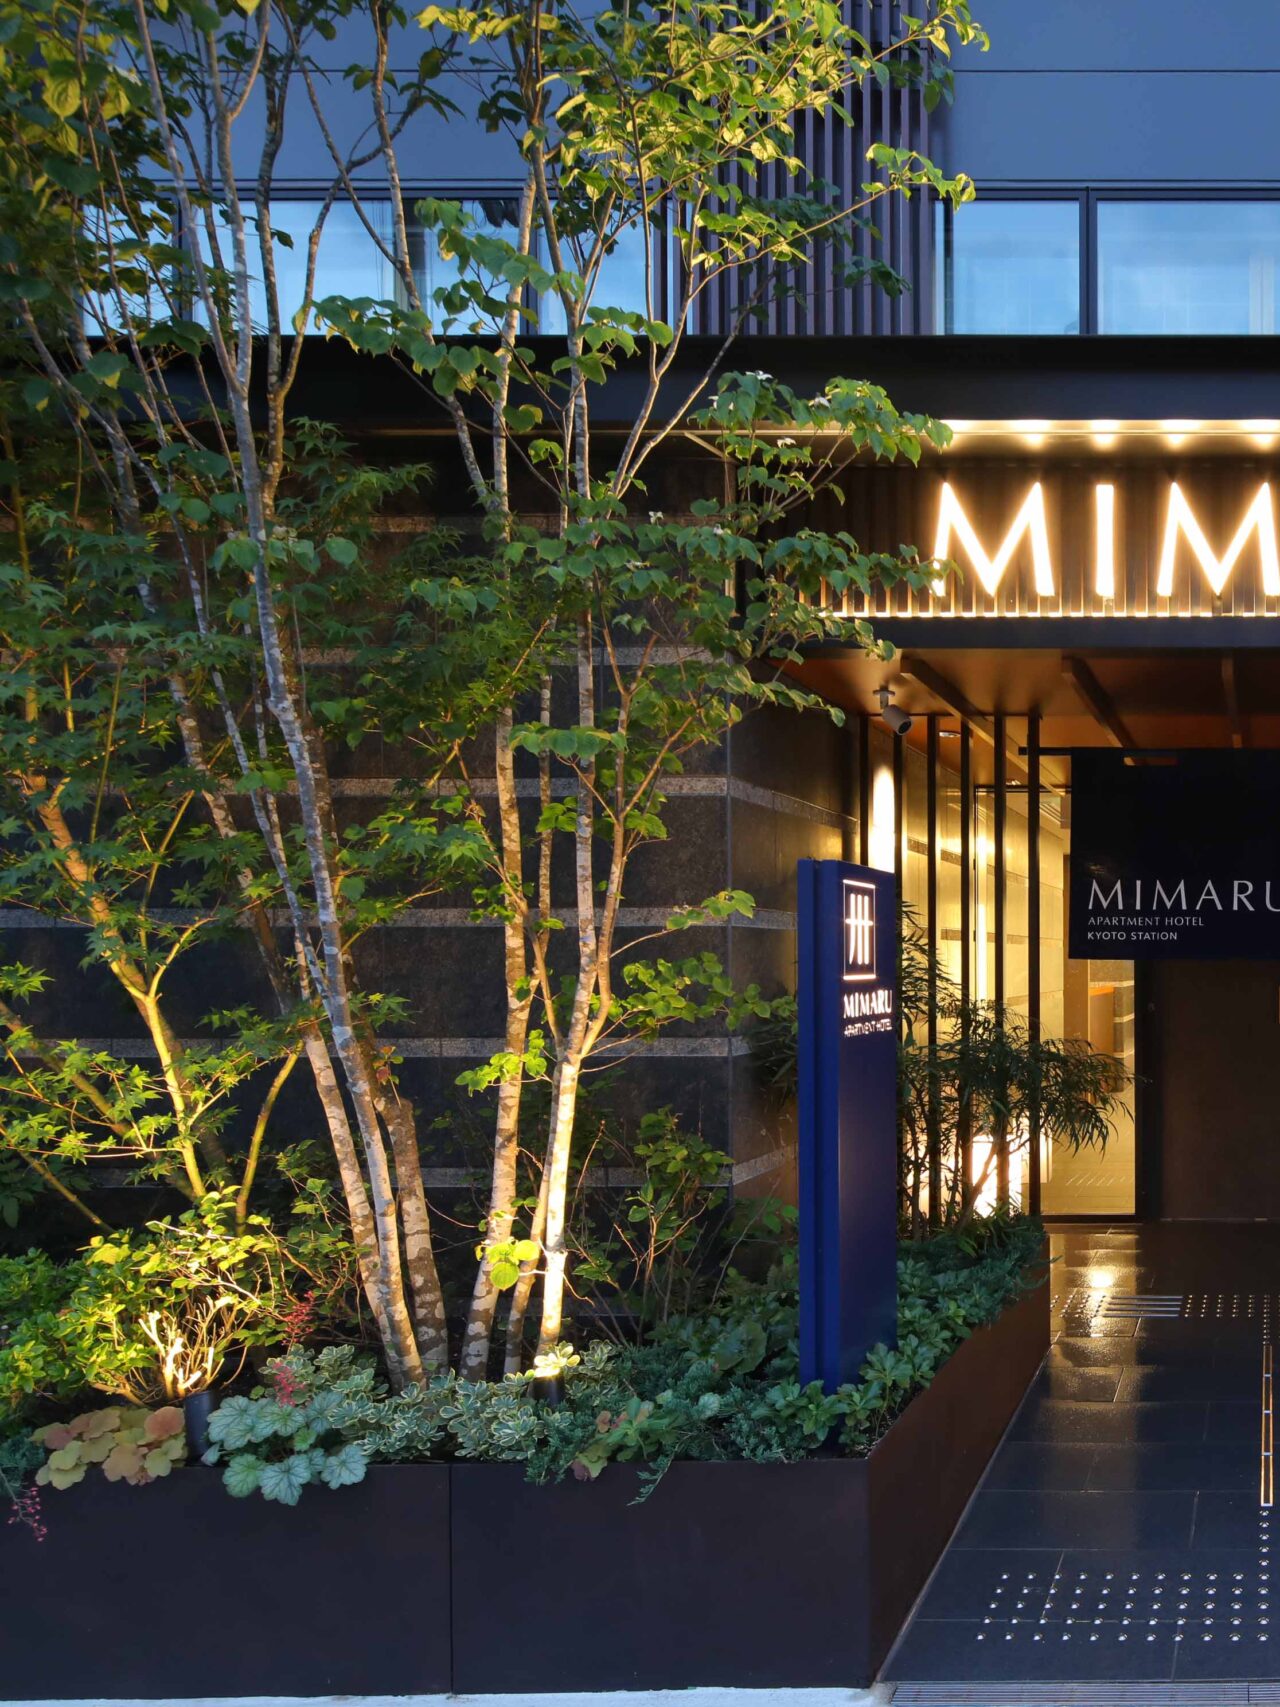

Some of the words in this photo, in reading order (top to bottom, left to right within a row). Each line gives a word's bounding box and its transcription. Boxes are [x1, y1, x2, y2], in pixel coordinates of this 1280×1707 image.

[1088, 916, 1160, 926] APARTMENT
[1165, 916, 1204, 926] HOTEL
[1087, 931, 1126, 940] KYOTO
[1130, 931, 1178, 940] STATION
[843, 989, 893, 1019] MIMARU
